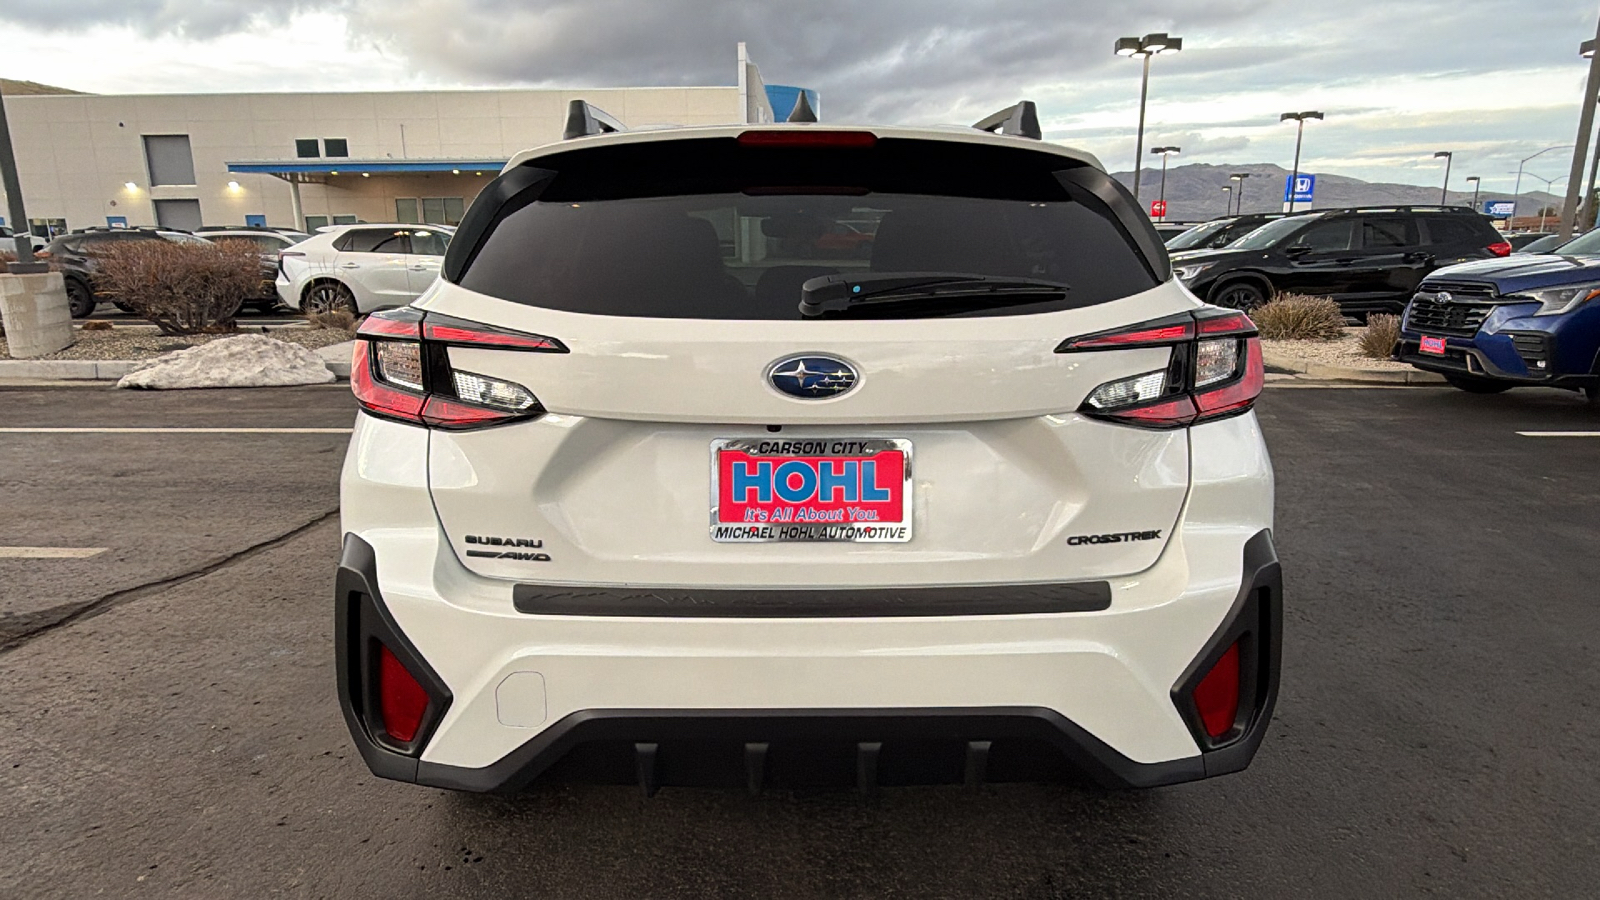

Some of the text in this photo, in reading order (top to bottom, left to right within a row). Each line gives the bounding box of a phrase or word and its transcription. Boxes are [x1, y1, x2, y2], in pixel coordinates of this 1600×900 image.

[758, 441, 868, 454] CARSON CITY
[732, 461, 890, 503] HOHL
[744, 507, 879, 521] It's All About You.
[715, 526, 907, 539] MICHAEL HOHL AUTOMOTIVE
[1066, 529, 1162, 546] CROSSTREK
[464, 534, 543, 549] SUBARU
[497, 551, 551, 561] AWD
